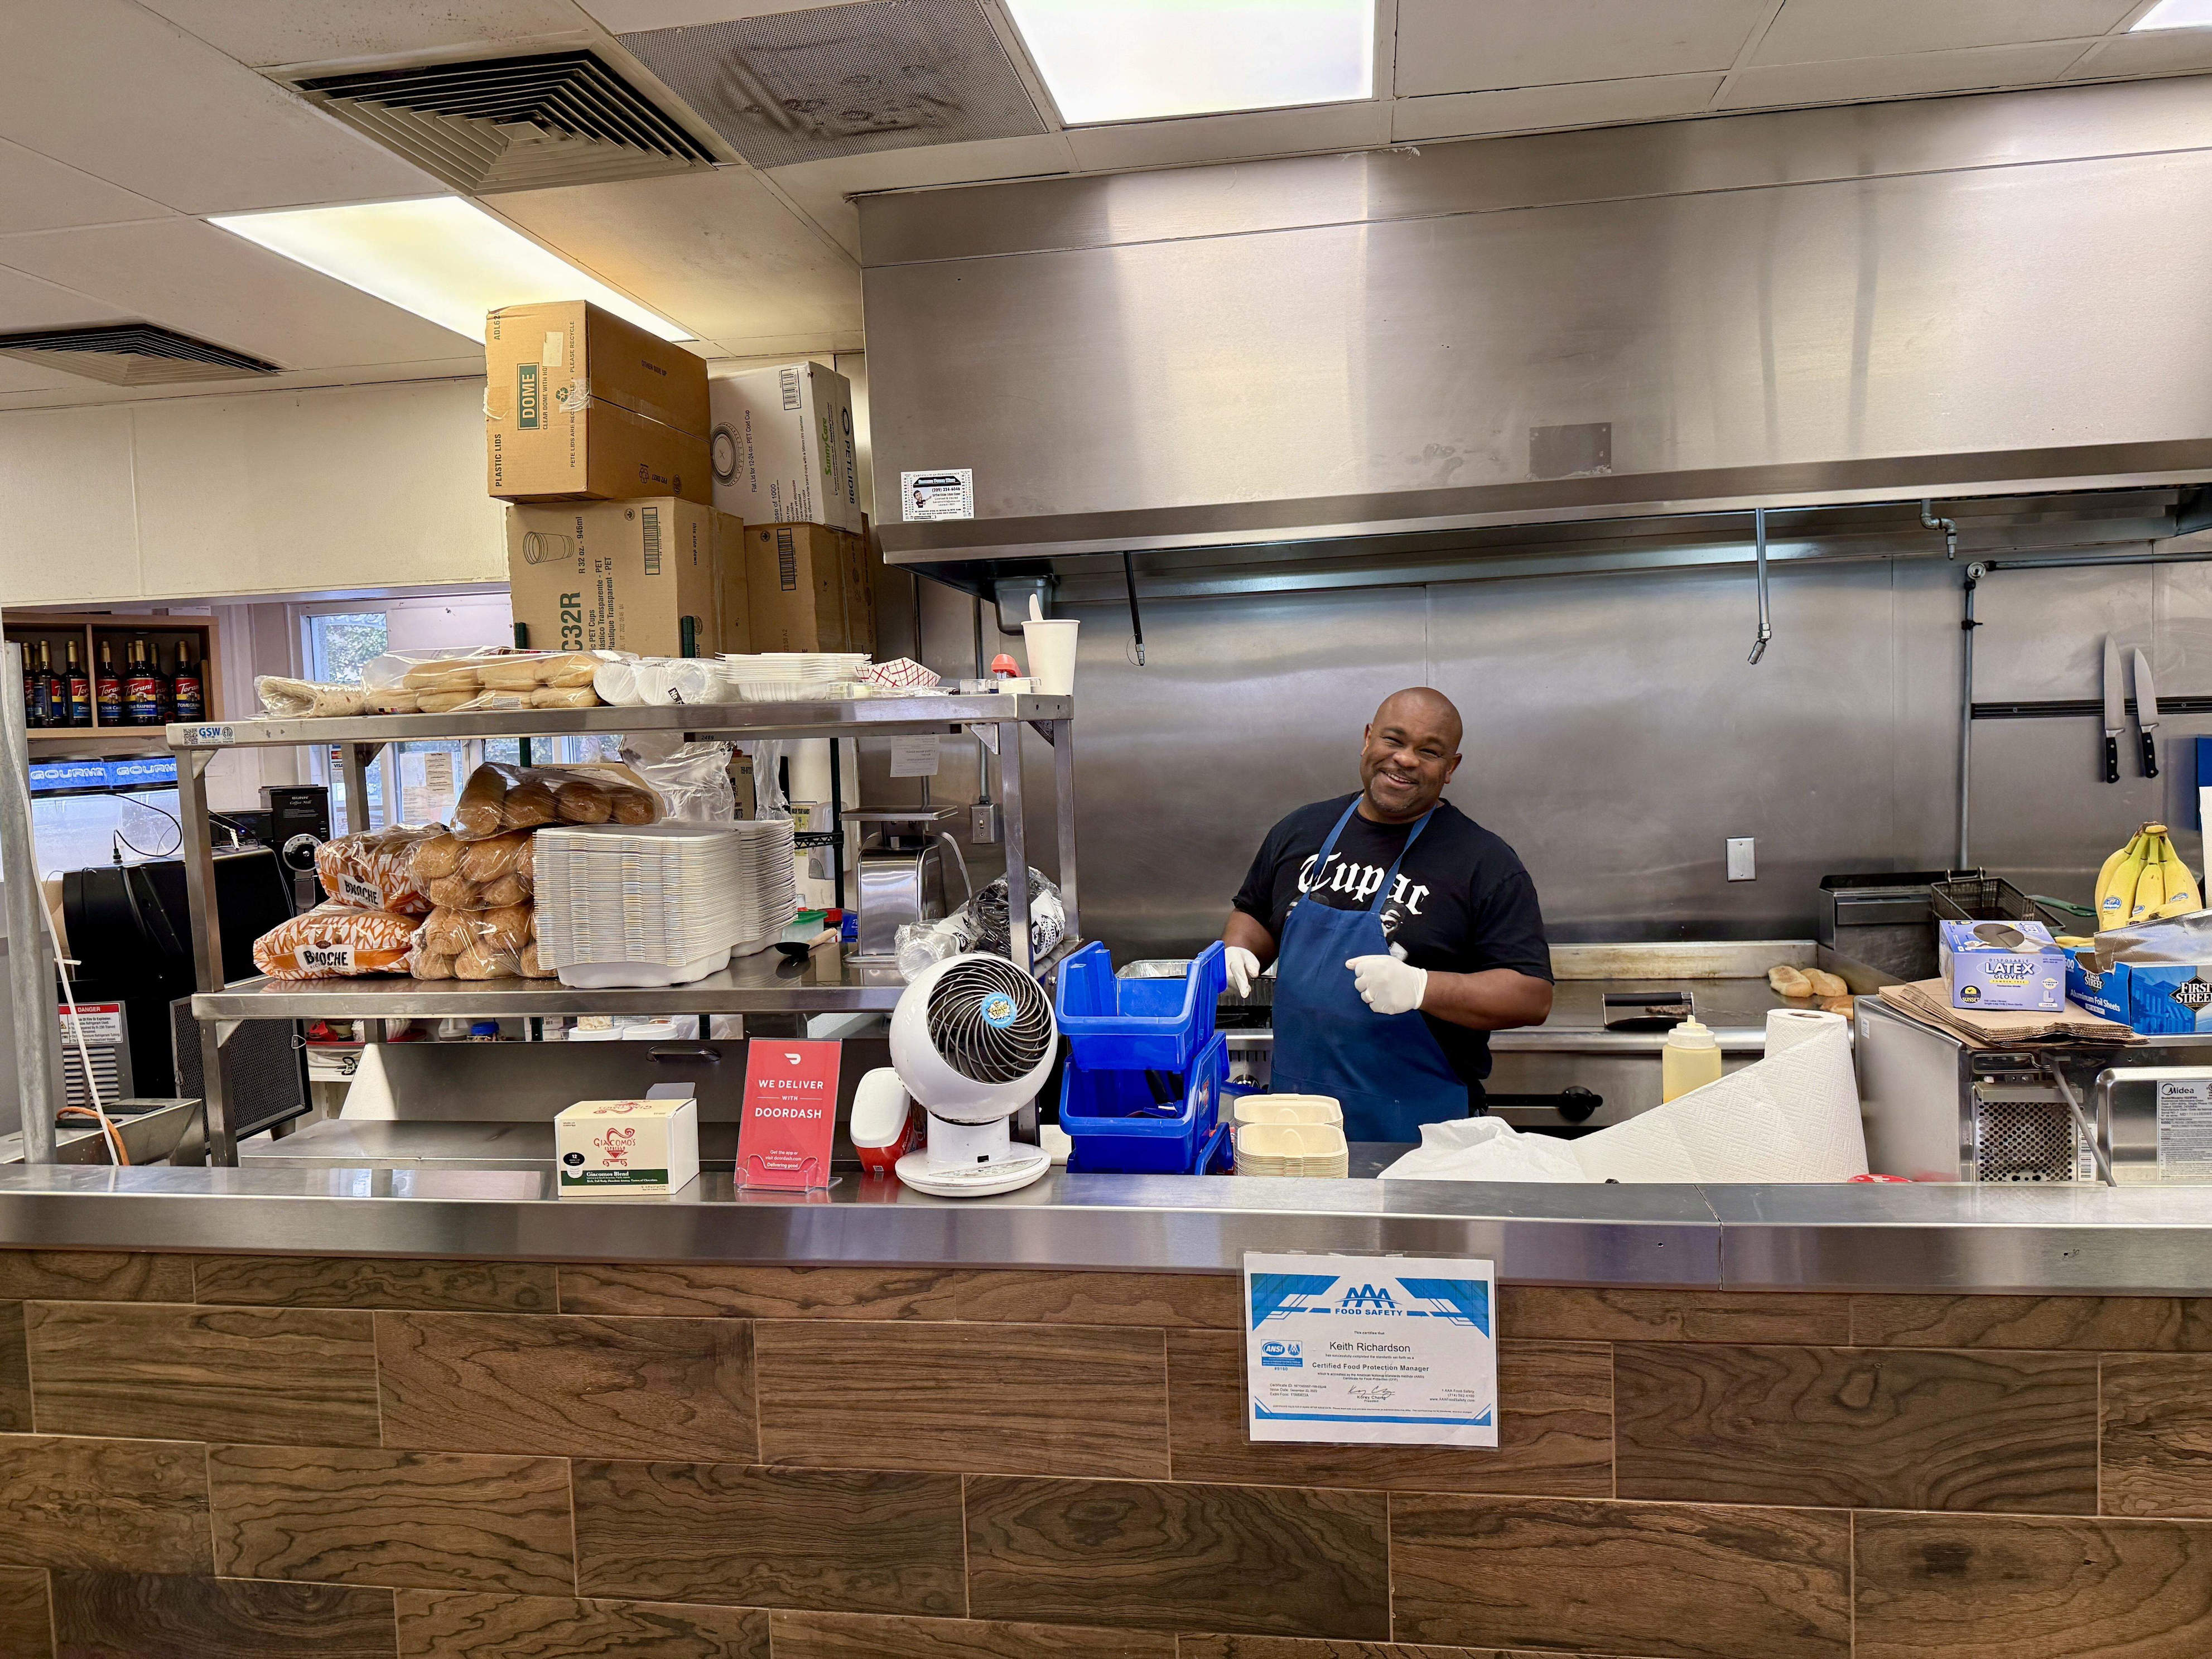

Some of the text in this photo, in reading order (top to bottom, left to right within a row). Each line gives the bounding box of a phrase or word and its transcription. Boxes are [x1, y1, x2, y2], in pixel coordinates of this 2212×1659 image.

[522, 373, 536, 419] DOME
[822, 417, 832, 475] SunnyCare
[845, 440, 855, 504] PETLID98
[579, 557, 585, 567] 32
[596, 582, 605, 625] Transparente
[606, 577, 615, 619] Transparent
[99, 684, 121, 697] Toran
[128, 682, 152, 698] Torani
[199, 727, 220, 736] GSW
[1297, 851, 1430, 915] Tupac
[1984, 962, 2035, 975] LATEX
[2084, 976, 2103, 990] STREET
[2180, 982, 2212, 994] FIRST
[2043, 990, 2055, 1002] L
[2070, 989, 2094, 1004] Aluminum
[2094, 996, 2103, 1006] Foil
[2103, 1000, 2121, 1012] Sheets
[758, 1079, 824, 1089] WE DELIVER
[755, 1107, 822, 1119] DOORDASH
[594, 1137, 636, 1148] GIACOMO'S
[1342, 1284, 1396, 1309] AAA
[1329, 1341, 1410, 1352] Keith Richardson
